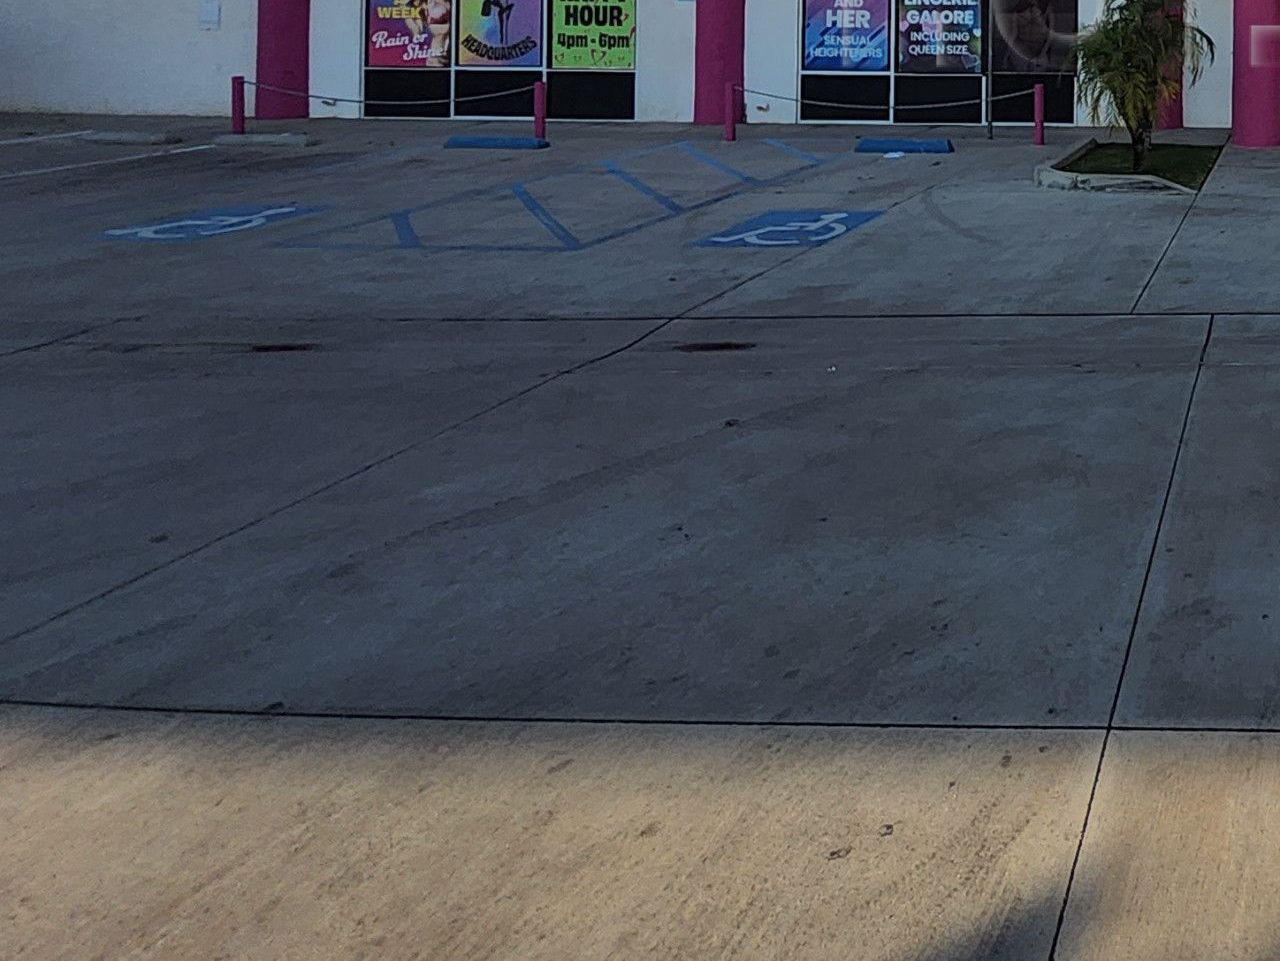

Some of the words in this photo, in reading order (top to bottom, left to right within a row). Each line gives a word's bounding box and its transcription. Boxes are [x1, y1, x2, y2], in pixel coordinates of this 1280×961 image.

[377, 7, 421, 20] WEEK
[564, 5, 623, 27] HOUR
[826, 9, 871, 28] HER
[906, 10, 975, 25] GALORE
[371, 30, 409, 48] Rain
[412, 33, 428, 45] or
[557, 33, 588, 49] 4pm
[598, 33, 630, 49] 6pm
[824, 35, 871, 46] SENSUAL
[910, 31, 971, 43] INCLUDING
[402, 38, 449, 62] Shine!
[461, 33, 538, 62] HEADQUARTERS
[908, 44, 945, 56] QUEEN
[946, 44, 969, 56] SIZE
